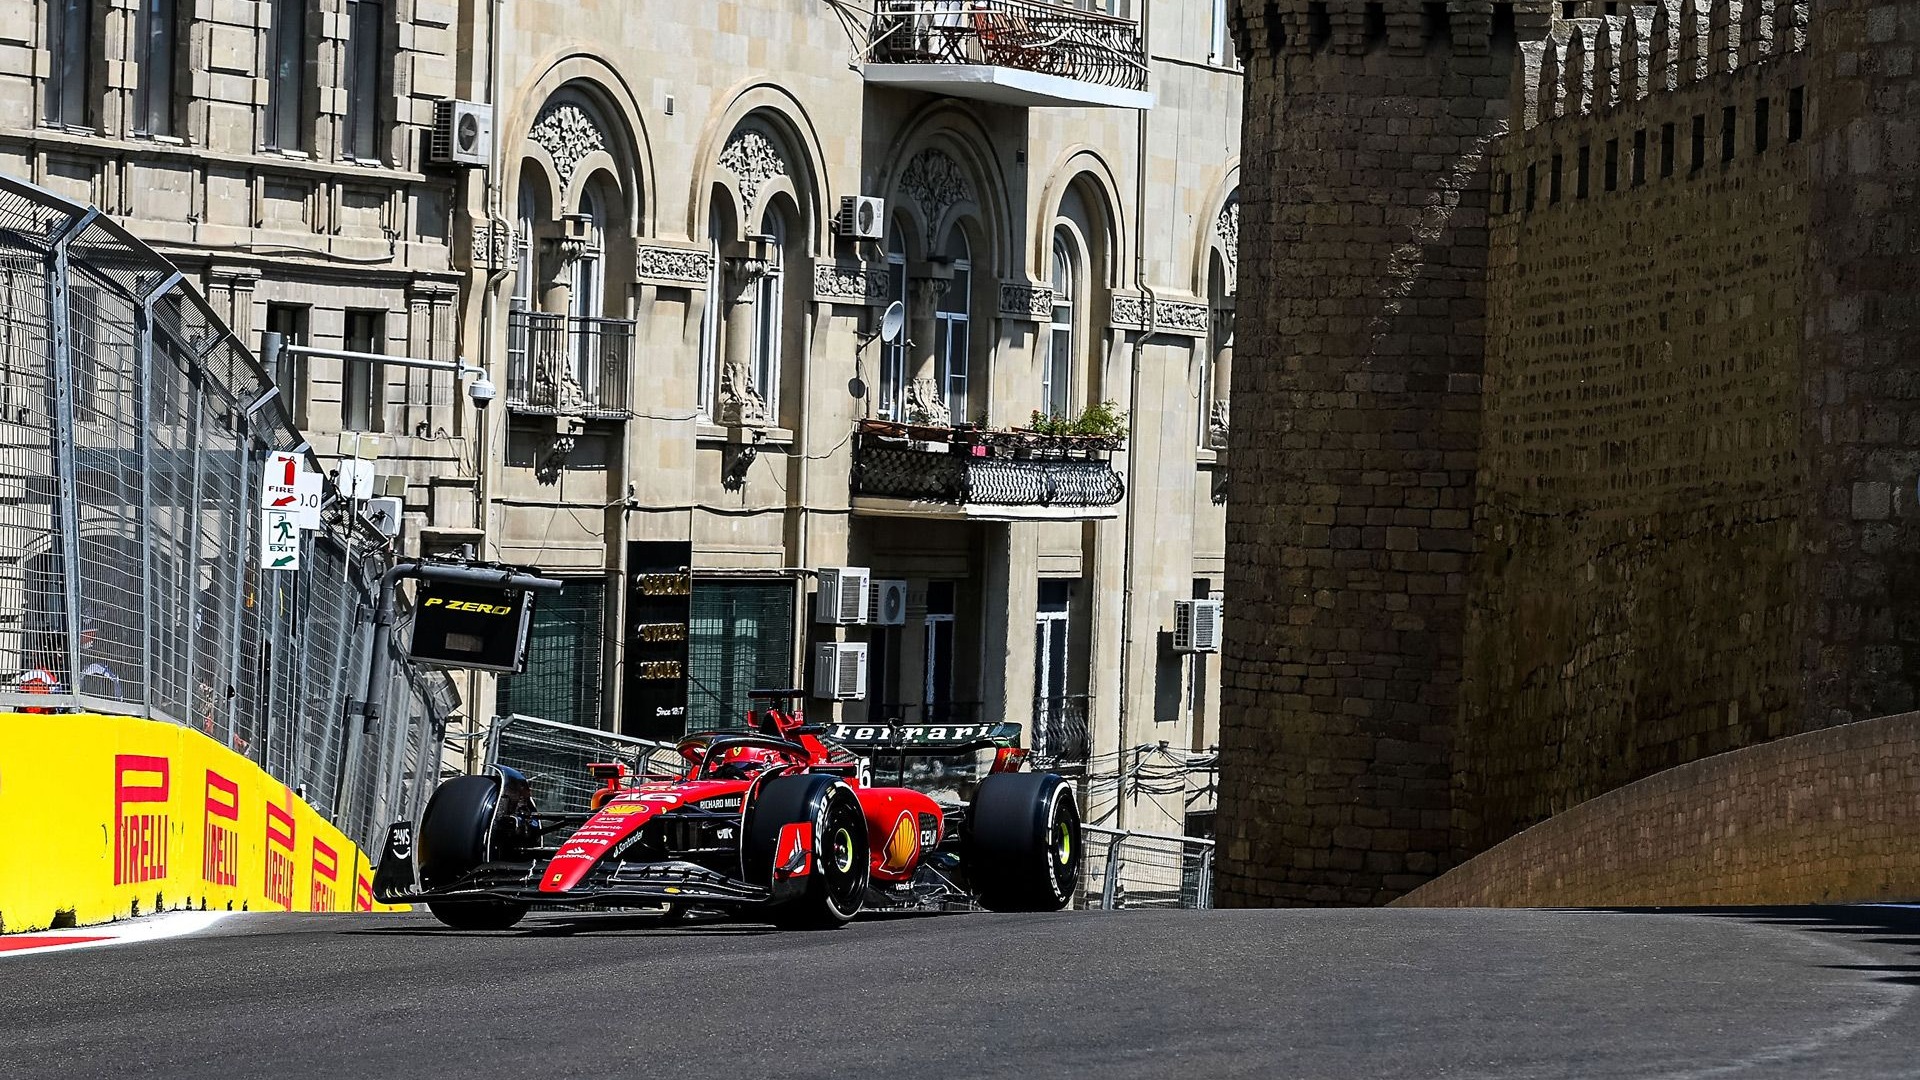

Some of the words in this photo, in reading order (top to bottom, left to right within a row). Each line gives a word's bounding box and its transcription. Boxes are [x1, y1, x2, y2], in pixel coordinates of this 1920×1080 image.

[268, 485, 294, 493] FIRE
[425, 598, 443, 607] P
[445, 600, 511, 615] ZERO
[830, 724, 990, 740] Ferrari
[700, 799, 723, 809] RICHARD
[725, 797, 741, 807] MILLE
[114, 754, 168, 886] PIRELLI
[203, 769, 239, 887] PIRELLI
[618, 829, 644, 854] Santander
[264, 801, 295, 911] PIRELLI
